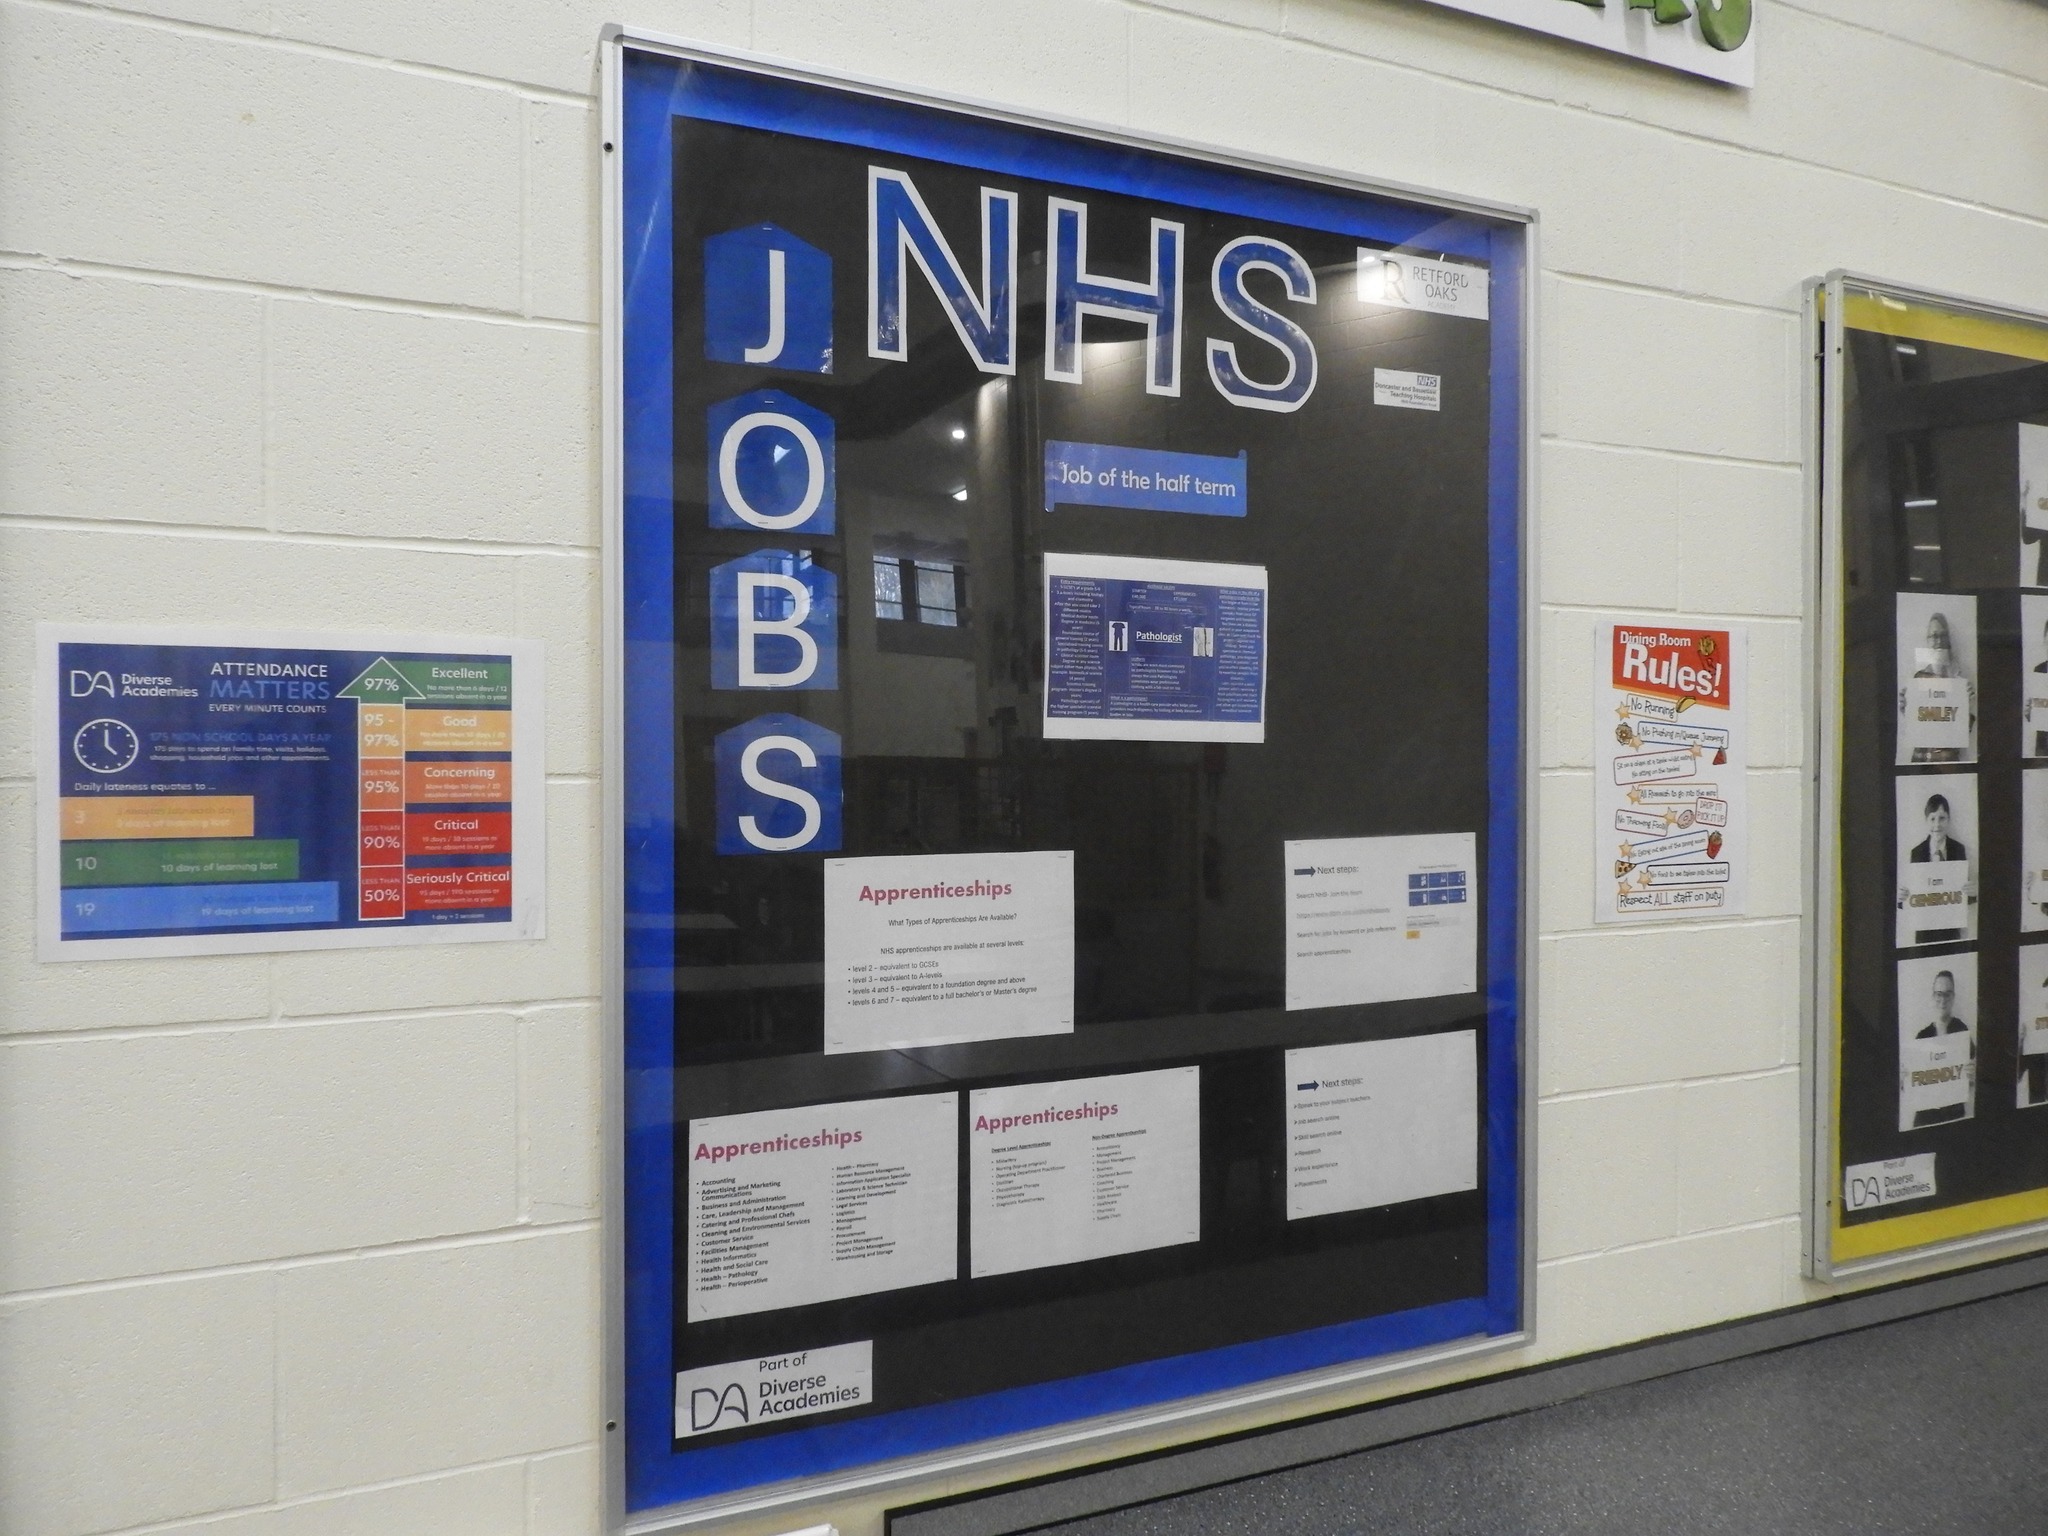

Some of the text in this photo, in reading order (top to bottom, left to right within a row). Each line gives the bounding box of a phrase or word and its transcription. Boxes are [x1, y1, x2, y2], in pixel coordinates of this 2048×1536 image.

[1413, 266, 1469, 288] RETFORD
[867, 165, 1318, 413] NHS
[1425, 284, 1458, 302] OAKS
[1375, 382, 1401, 390] Doncaster
[1418, 376, 1437, 387] NHS
[1390, 391, 1413, 400] Teaching
[1062, 464, 1236, 497] Job of the half term
[719, 250, 826, 852] JOBS
[1136, 631, 1183, 642] Pathologist
[1620, 631, 1691, 647] Dining Room
[210, 662, 328, 678] ATTENDANCE
[432, 668, 488, 679] Excellent
[1622, 643, 1722, 698] Rules!
[70, 670, 115, 698] DA
[122, 674, 172, 686] Diverse
[364, 678, 400, 692] 97%
[122, 686, 199, 698] Academies
[209, 679, 331, 700] MATTERS
[208, 704, 327, 713] EVERY MINUTE COUNTS
[1631, 698, 1675, 719] No Running
[364, 714, 384, 727] 95
[443, 716, 477, 727] Good
[364, 734, 400, 747] 97%
[424, 768, 496, 780] Concerning
[74, 782, 206, 793] Daily lateness equates to
[364, 781, 400, 794] 95%
[434, 820, 479, 831] Critical
[364, 836, 401, 849] 90%
[76, 857, 97, 870] 10
[161, 862, 279, 874] 10 days of learning lost
[1317, 866, 1359, 874] Next steps:
[406, 872, 463, 885] Seriously
[466, 872, 510, 882] Critical
[364, 890, 400, 902] 50%
[858, 880, 1012, 906] Apprenticeships
[1620, 894, 1653, 908] Respect
[1654, 892, 1672, 906] ALL
[1673, 892, 1693, 904] staff
[76, 903, 96, 916] 19
[888, 919, 904, 927] What
[906, 918, 923, 928] Types
[932, 915, 977, 925] Apprenticeships
[990, 912, 1018, 922] Available?
[880, 947, 895, 955] NHS
[896, 944, 942, 955] apprenticeships
[943, 944, 953, 952] are
[954, 942, 978, 951] available
[986, 940, 1007, 948] several
[880, 962, 910, 971] equivalent
[919, 960, 939, 969] GCSEs
[852, 976, 867, 984] level
[880, 974, 910, 983] equivalent
[918, 972, 943, 980] A-levels
[902, 983, 932, 992] equivalent
[946, 980, 976, 988] foundation
[976, 978, 996, 987] degree
[998, 976, 1008, 984] and
[902, 994, 932, 1003] equivalent
[955, 990, 985, 999] bachelor's
[1018, 986, 1037, 995] degree
[1322, 1078, 1363, 1088] Next steps:
[975, 1102, 1119, 1134] Apprenticeships
[694, 1128, 863, 1163] Apprenticeships
[701, 1177, 736, 1187] Accounting
[1884, 1174, 1914, 1187] Diverse
[701, 1186, 736, 1195] Advertising
[750, 1181, 781, 1189] Marketing
[1852, 1176, 1881, 1207] DA
[1885, 1183, 1931, 1200] Academies
[702, 1190, 752, 1202] Communications
[702, 1203, 728, 1211] Business
[742, 1195, 787, 1205] Administration
[718, 1207, 752, 1218] Leadership
[766, 1202, 805, 1211] Management
[701, 1220, 727, 1229] Catering
[742, 1212, 778, 1223] Professional
[702, 1229, 728, 1238] Cleaning
[742, 1220, 785, 1232] Environmental
[786, 1219, 811, 1227] Services
[702, 1234, 754, 1247] Customer Service
[701, 1242, 769, 1256] Facilities Management
[723, 1253, 757, 1261] Informatics
[701, 1266, 722, 1274] Health
[736, 1261, 754, 1269] Social
[759, 1353, 808, 1373] Part of
[759, 1374, 827, 1398] Diverse
[691, 1382, 749, 1432] DA
[759, 1386, 860, 1417] Academies
